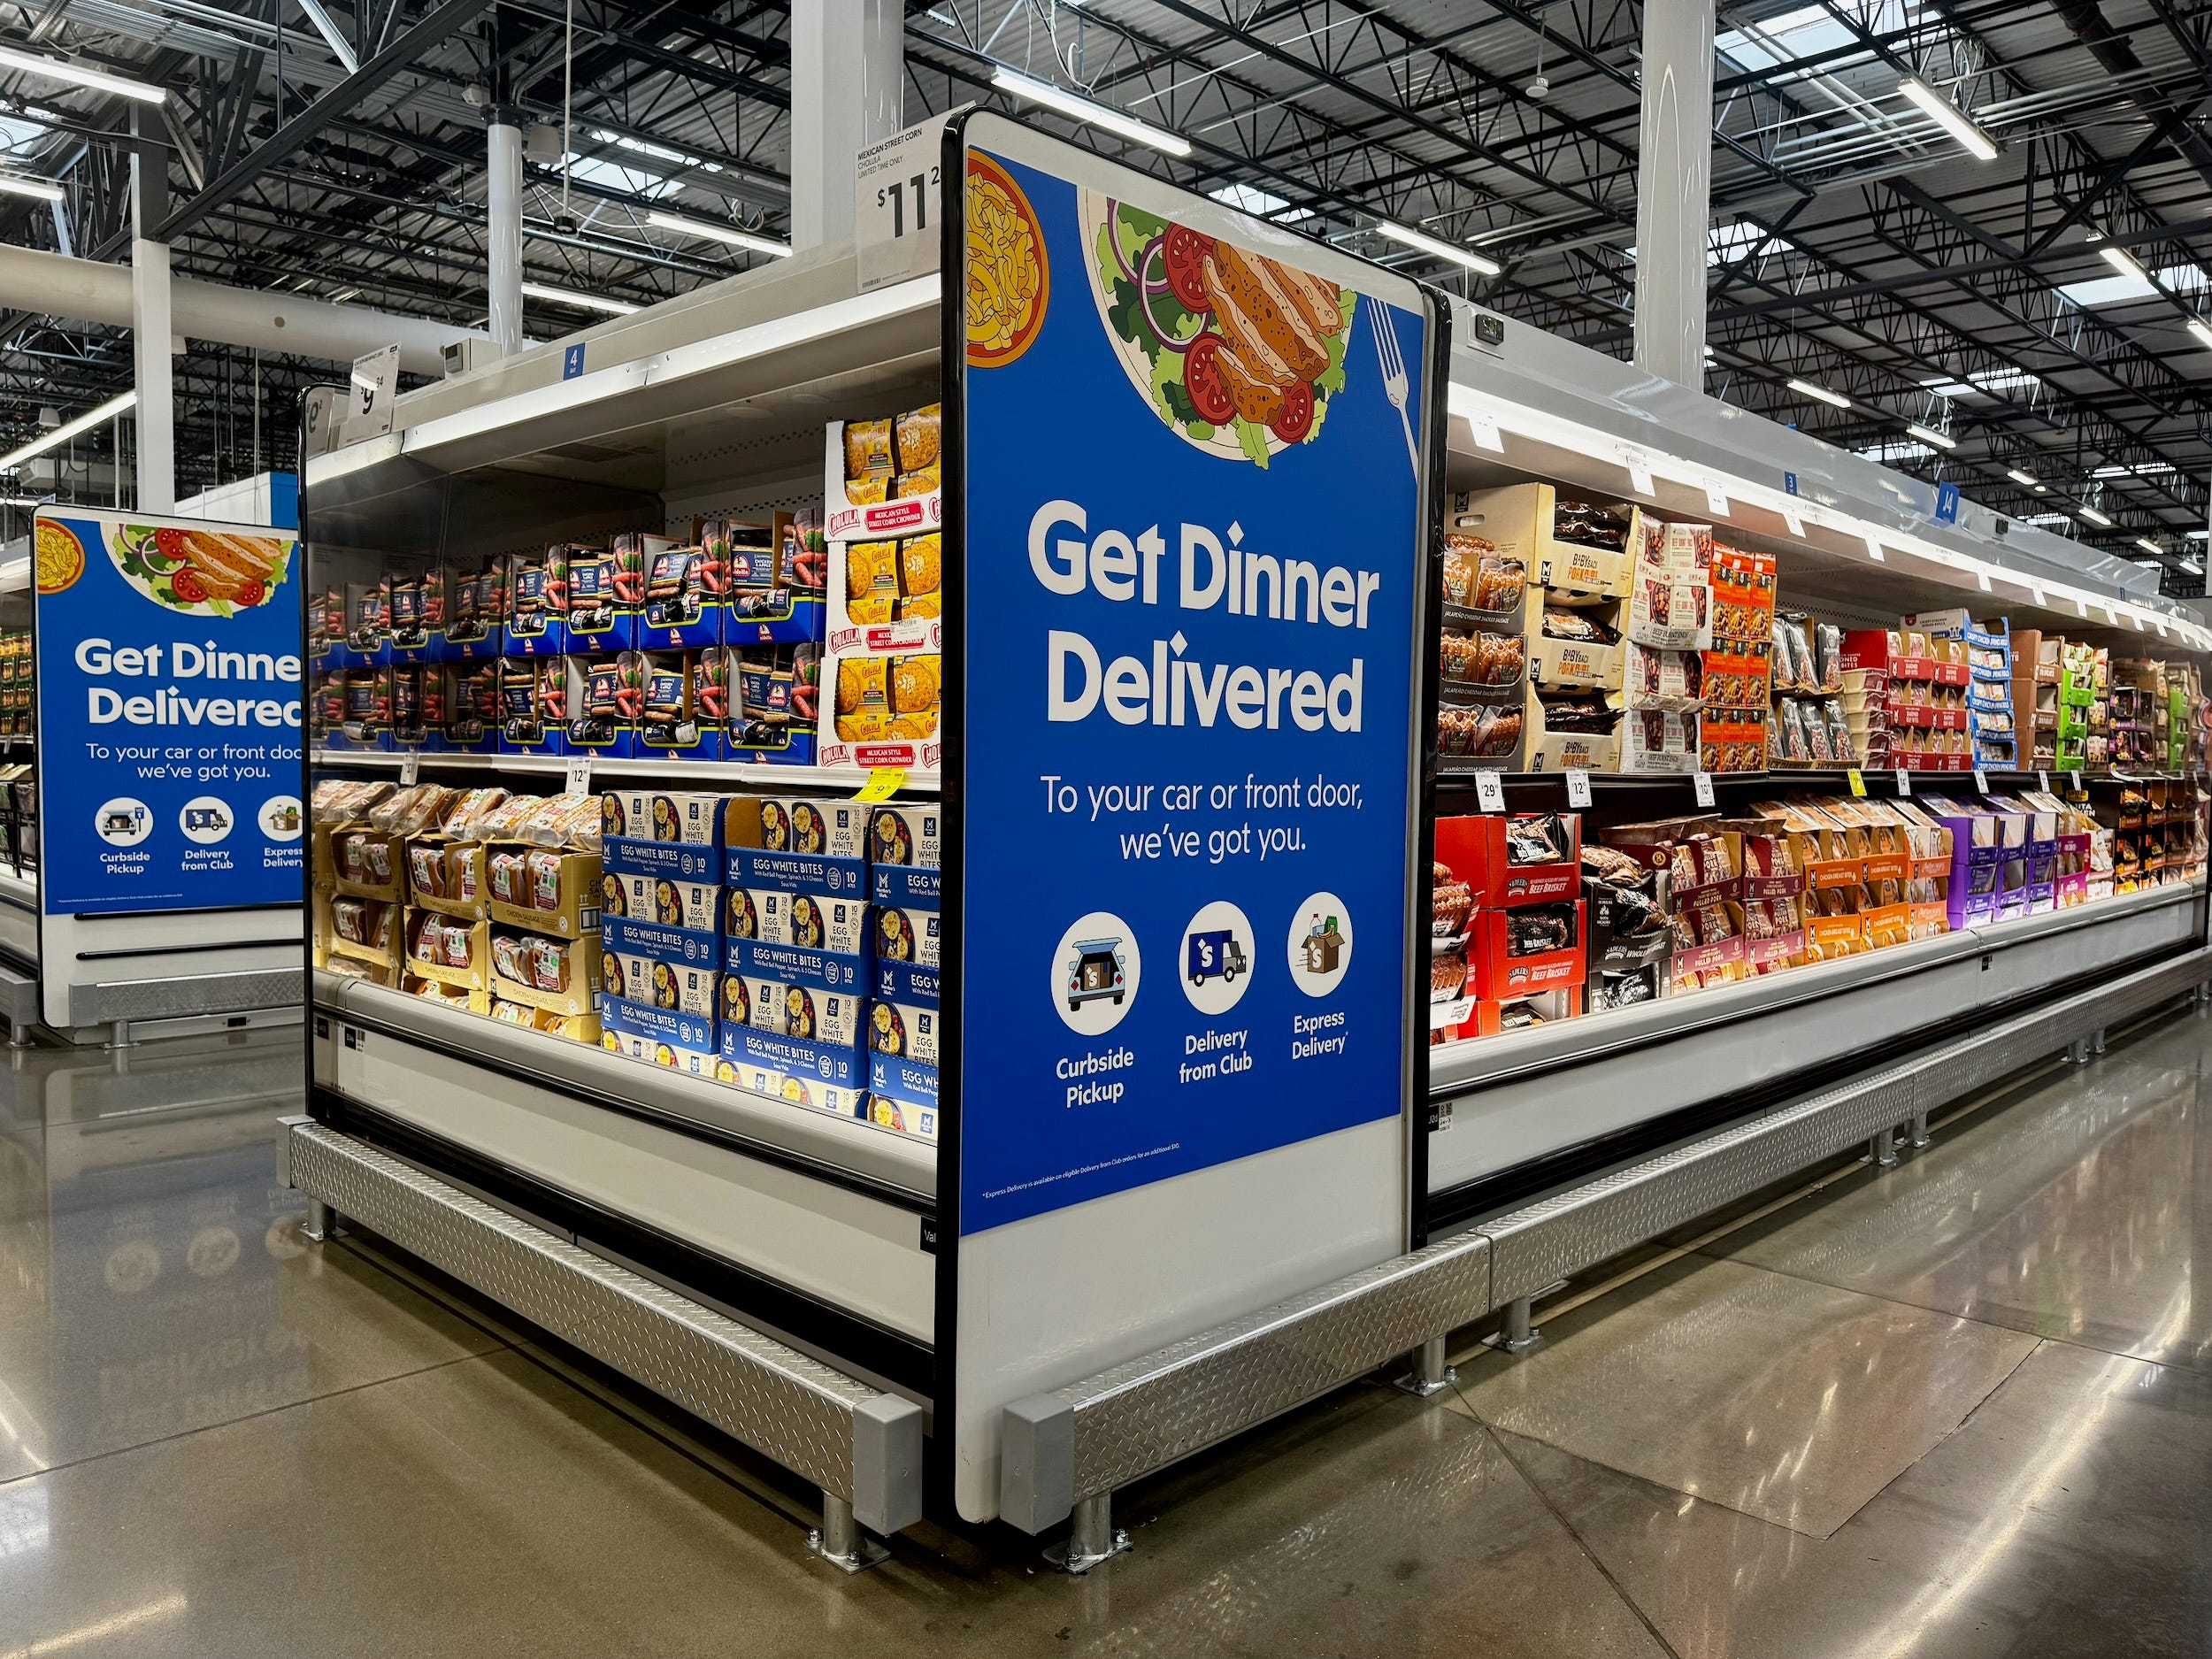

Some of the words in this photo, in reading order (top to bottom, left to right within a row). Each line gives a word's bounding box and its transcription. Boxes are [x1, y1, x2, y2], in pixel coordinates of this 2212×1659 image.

[857, 143, 884, 161] MEXICAN
[885, 134, 904, 150] STREET
[905, 127, 922, 141] CORN
[858, 157, 881, 170] CHOLULA
[858, 165, 876, 179] LIMITED
[877, 162, 888, 171] TIME
[888, 155, 903, 168] ONLY
[571, 349, 578, 366] 4
[1788, 476, 1793, 488] 3
[1942, 490, 1953, 514] J4
[828, 509, 860, 536] CHOLULA
[896, 513, 920, 524] CHOWDER
[872, 549, 891, 563] CHOLULA
[1573, 553, 1588, 566] BABY
[1028, 499, 1164, 604] Get
[1180, 519, 1379, 629] Dinner
[868, 605, 887, 619] CHOLULA
[828, 628, 861, 654] CHOLULA
[74, 637, 163, 677] Get
[173, 640, 301, 682] Dinne
[1563, 649, 1578, 662] BABY
[862, 665, 881, 679] CHOLULA
[1048, 630, 1363, 733] Delivered
[860, 723, 880, 735] CHOLULA
[86, 743, 110, 759] To
[116, 746, 159, 763] your
[165, 746, 193, 759] car
[198, 746, 217, 759] or
[223, 743, 265, 759] front
[270, 744, 302, 760] doo
[819, 745, 850, 767] CHOLULA
[137, 763, 192, 779] we've
[198, 764, 228, 781] got
[234, 766, 271, 781] you.
[1041, 776, 1078, 812] To
[1087, 783, 1154, 821] your
[1162, 784, 1202, 810] car
[1210, 784, 1237, 810] or
[1245, 773, 1301, 810] front
[1308, 774, 1363, 810] door,
[1120, 824, 1200, 859] we've
[1209, 822, 1251, 864] got
[1258, 826, 1306, 861] you.
[100, 851, 150, 863] Curbside
[185, 849, 229, 860] Delivery
[264, 848, 303, 857] Express
[621, 845, 634, 856] EGG
[635, 847, 657, 859] WHITE
[658, 849, 678, 861] BITES
[107, 864, 144, 874] Pickup
[181, 862, 207, 872] from
[210, 860, 234, 870] Club
[697, 858, 705, 868] 10
[754, 859, 770, 870] EGG
[772, 861, 797, 872] WHITE
[800, 863, 823, 875] BITES
[846, 872, 856, 883] 10
[908, 875, 928, 887] EGG
[1529, 884, 1543, 895] BEEF
[1543, 883, 1567, 893] BRISKET
[1694, 897, 1711, 908] PULLED
[1712, 895, 1722, 903] PORK
[624, 926, 638, 937] EGG
[639, 929, 661, 941] WHITE
[662, 933, 682, 945] BITES
[762, 926, 781, 935] WHITE
[833, 926, 848, 935] EGG
[829, 936, 851, 945] WHITE
[925, 941, 940, 950] EGG
[700, 944, 708, 956] 10
[920, 950, 940, 961] WHIT
[1764, 949, 1778, 958] PULLED
[754, 948, 770, 959] EGG
[772, 950, 796, 964] WHITE
[799, 955, 821, 968] BITES
[1694, 956, 1712, 967] PULLED
[1714, 953, 1724, 963] PORK
[844, 967, 853, 979] 10
[1532, 971, 1546, 981] BEEF
[1546, 966, 1571, 979] BRISKET
[911, 974, 931, 988] EGG
[620, 1005, 634, 1017] EGG
[634, 1009, 657, 1022] WHITE
[657, 1014, 676, 1027] BITES
[757, 1006, 771, 1015] EGG
[755, 1015, 774, 1025] WHITE
[824, 1019, 840, 1029] EGG
[1294, 1011, 1345, 1035] Express
[695, 1027, 703, 1038] 10
[821, 1028, 844, 1040] WHITE
[746, 1037, 763, 1050] EGG
[764, 1041, 790, 1056] WHITE
[791, 1047, 815, 1061] BITES
[917, 1037, 933, 1048] EGG
[1185, 1030, 1248, 1056] Delivery
[912, 1046, 937, 1058] WHITE
[838, 1062, 848, 1073] 10
[1056, 1048, 1133, 1081] Curbside
[1179, 1063, 1216, 1084] from
[1220, 1053, 1253, 1076] Club
[902, 1069, 922, 1084] EGG
[1066, 1081, 1125, 1108] Pickup
[1007, 1182, 1028, 1194] Delivery
[1033, 1175, 1055, 1187] available
[1063, 1168, 1079, 1179] eligible
[1080, 1164, 1100, 1174] Delivery
[1122, 1154, 1137, 1163] orders
[1150, 1145, 1171, 1156] additional
